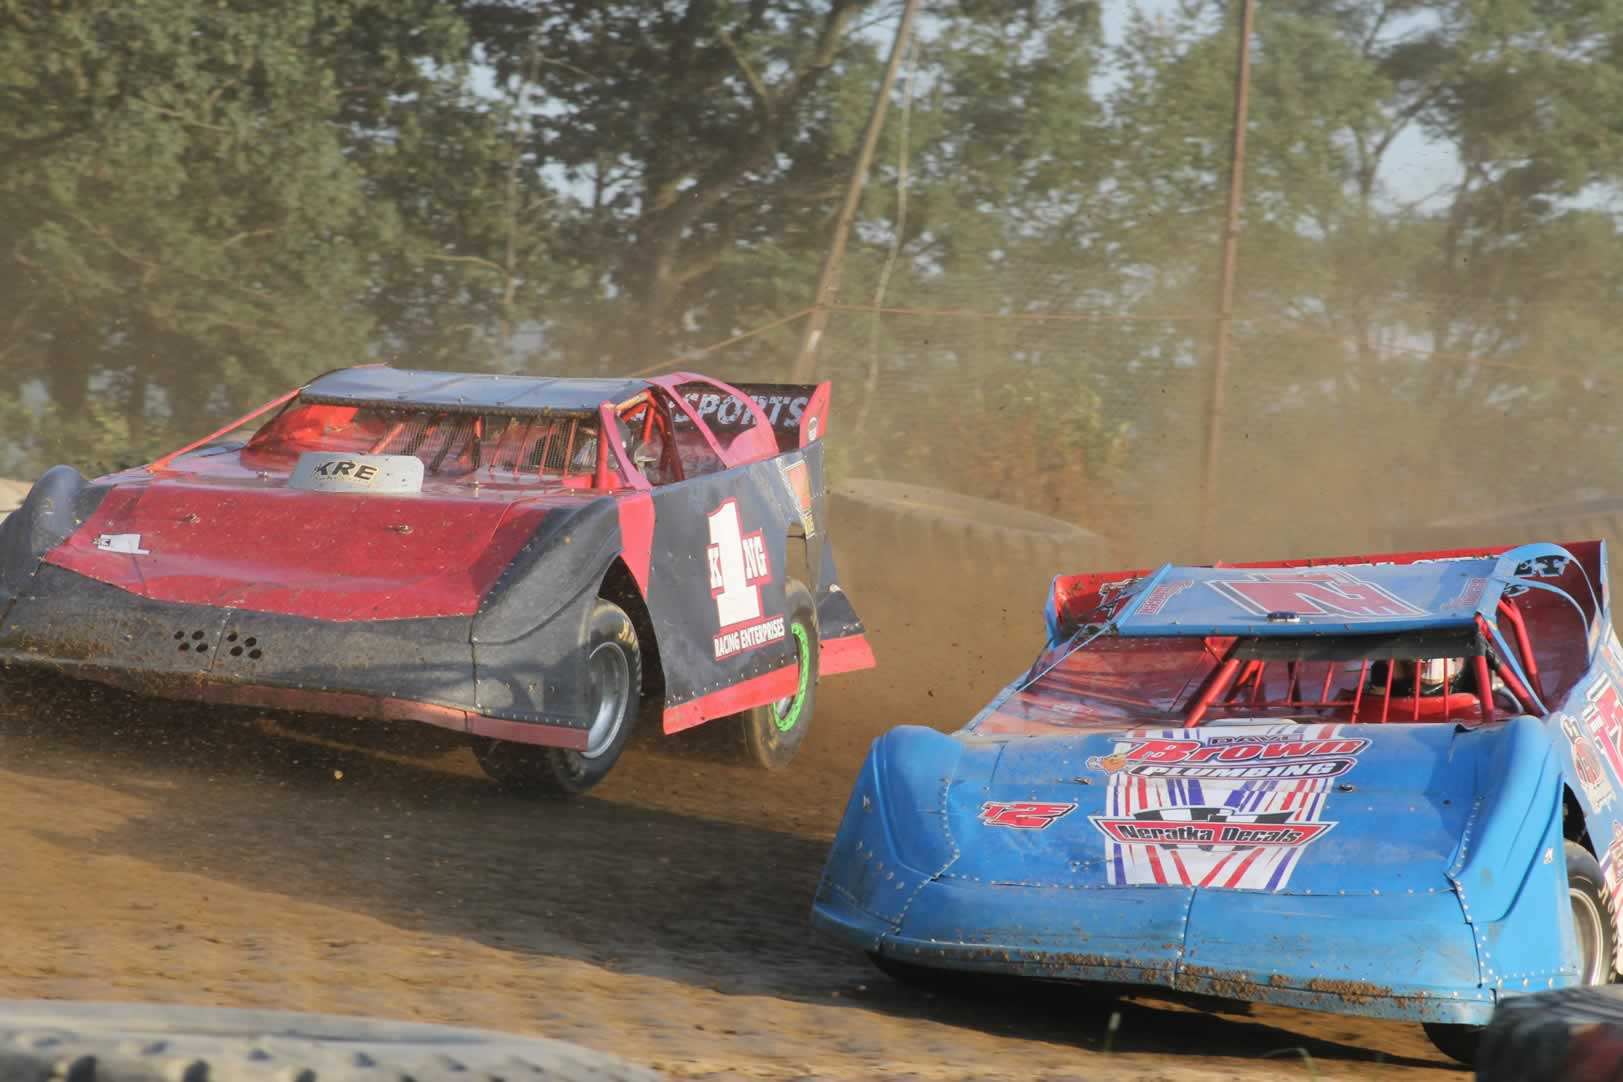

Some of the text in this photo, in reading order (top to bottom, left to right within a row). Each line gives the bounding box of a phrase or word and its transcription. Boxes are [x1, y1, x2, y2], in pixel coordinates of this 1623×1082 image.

[313, 460, 378, 481] KRE
[713, 618, 785, 658] RACING ENTERPRISES
[1143, 762, 1337, 778] PLUMBING
[1116, 825, 1303, 843] Neratka Decals
